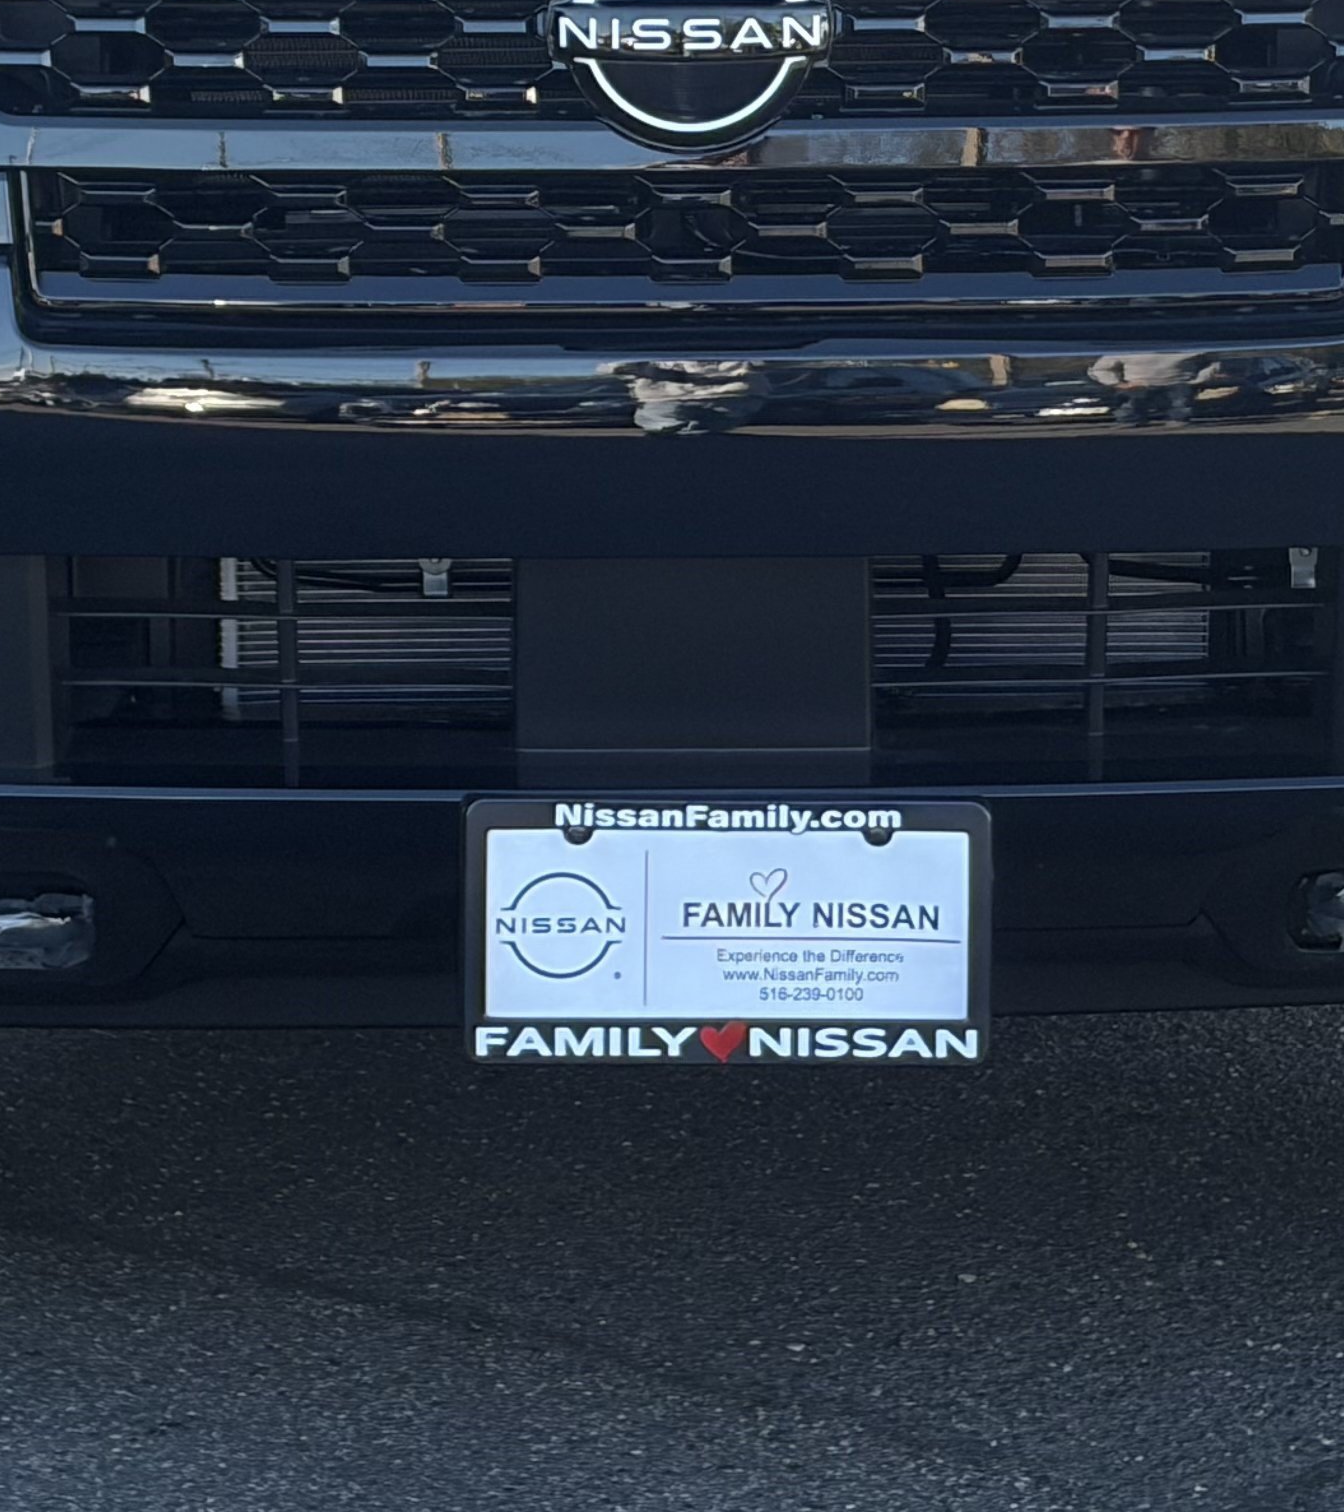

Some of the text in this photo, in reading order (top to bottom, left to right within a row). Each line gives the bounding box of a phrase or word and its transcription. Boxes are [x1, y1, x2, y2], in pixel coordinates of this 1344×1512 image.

[558, 14, 821, 52] NISSAN
[555, 802, 902, 833] NissanFamily.com
[495, 917, 626, 934] NISSAN
[682, 901, 940, 931] FAMILY NISSAN
[716, 948, 904, 965] Experience the Difference
[722, 967, 900, 985] www.NissanFamily.com
[759, 987, 864, 1002] 516-239-0100
[474, 1026, 979, 1059] FAMILY NISSAN
